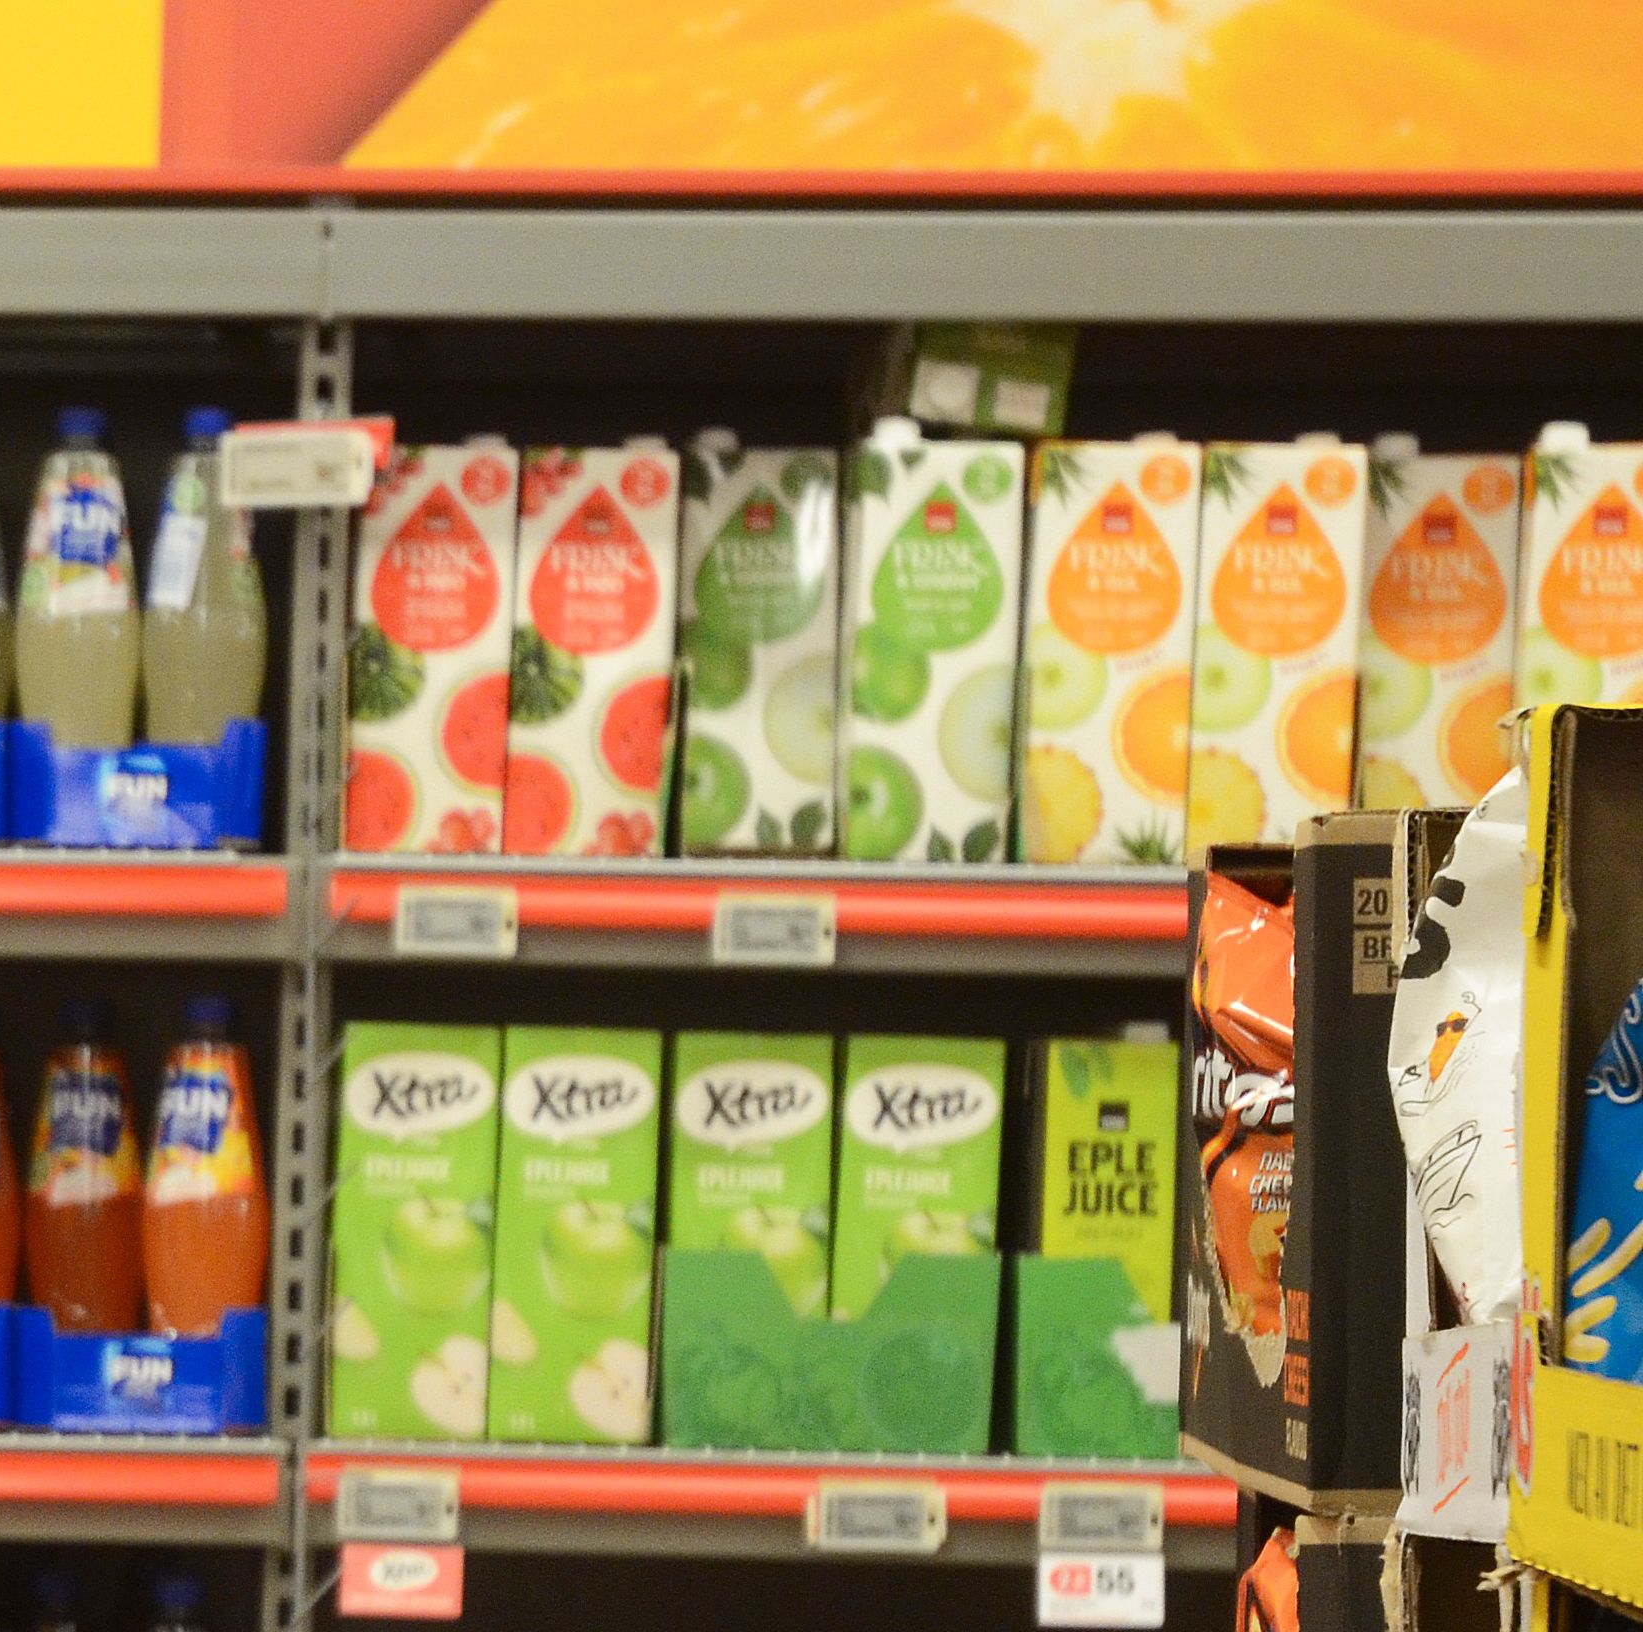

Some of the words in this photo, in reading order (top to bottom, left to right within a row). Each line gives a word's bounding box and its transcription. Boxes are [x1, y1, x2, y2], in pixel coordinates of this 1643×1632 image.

[1357, 888, 1389, 916] 20
[158, 1089, 229, 1124] FUN
[372, 1070, 481, 1120] Xtra
[531, 1073, 640, 1123] Xtra
[704, 1078, 814, 1130] Xtra
[873, 1081, 983, 1131] Xtra
[1192, 1047, 1294, 1126] ritos
[1068, 1139, 1157, 1178] EPLE
[1062, 1180, 1159, 1218] JUICE
